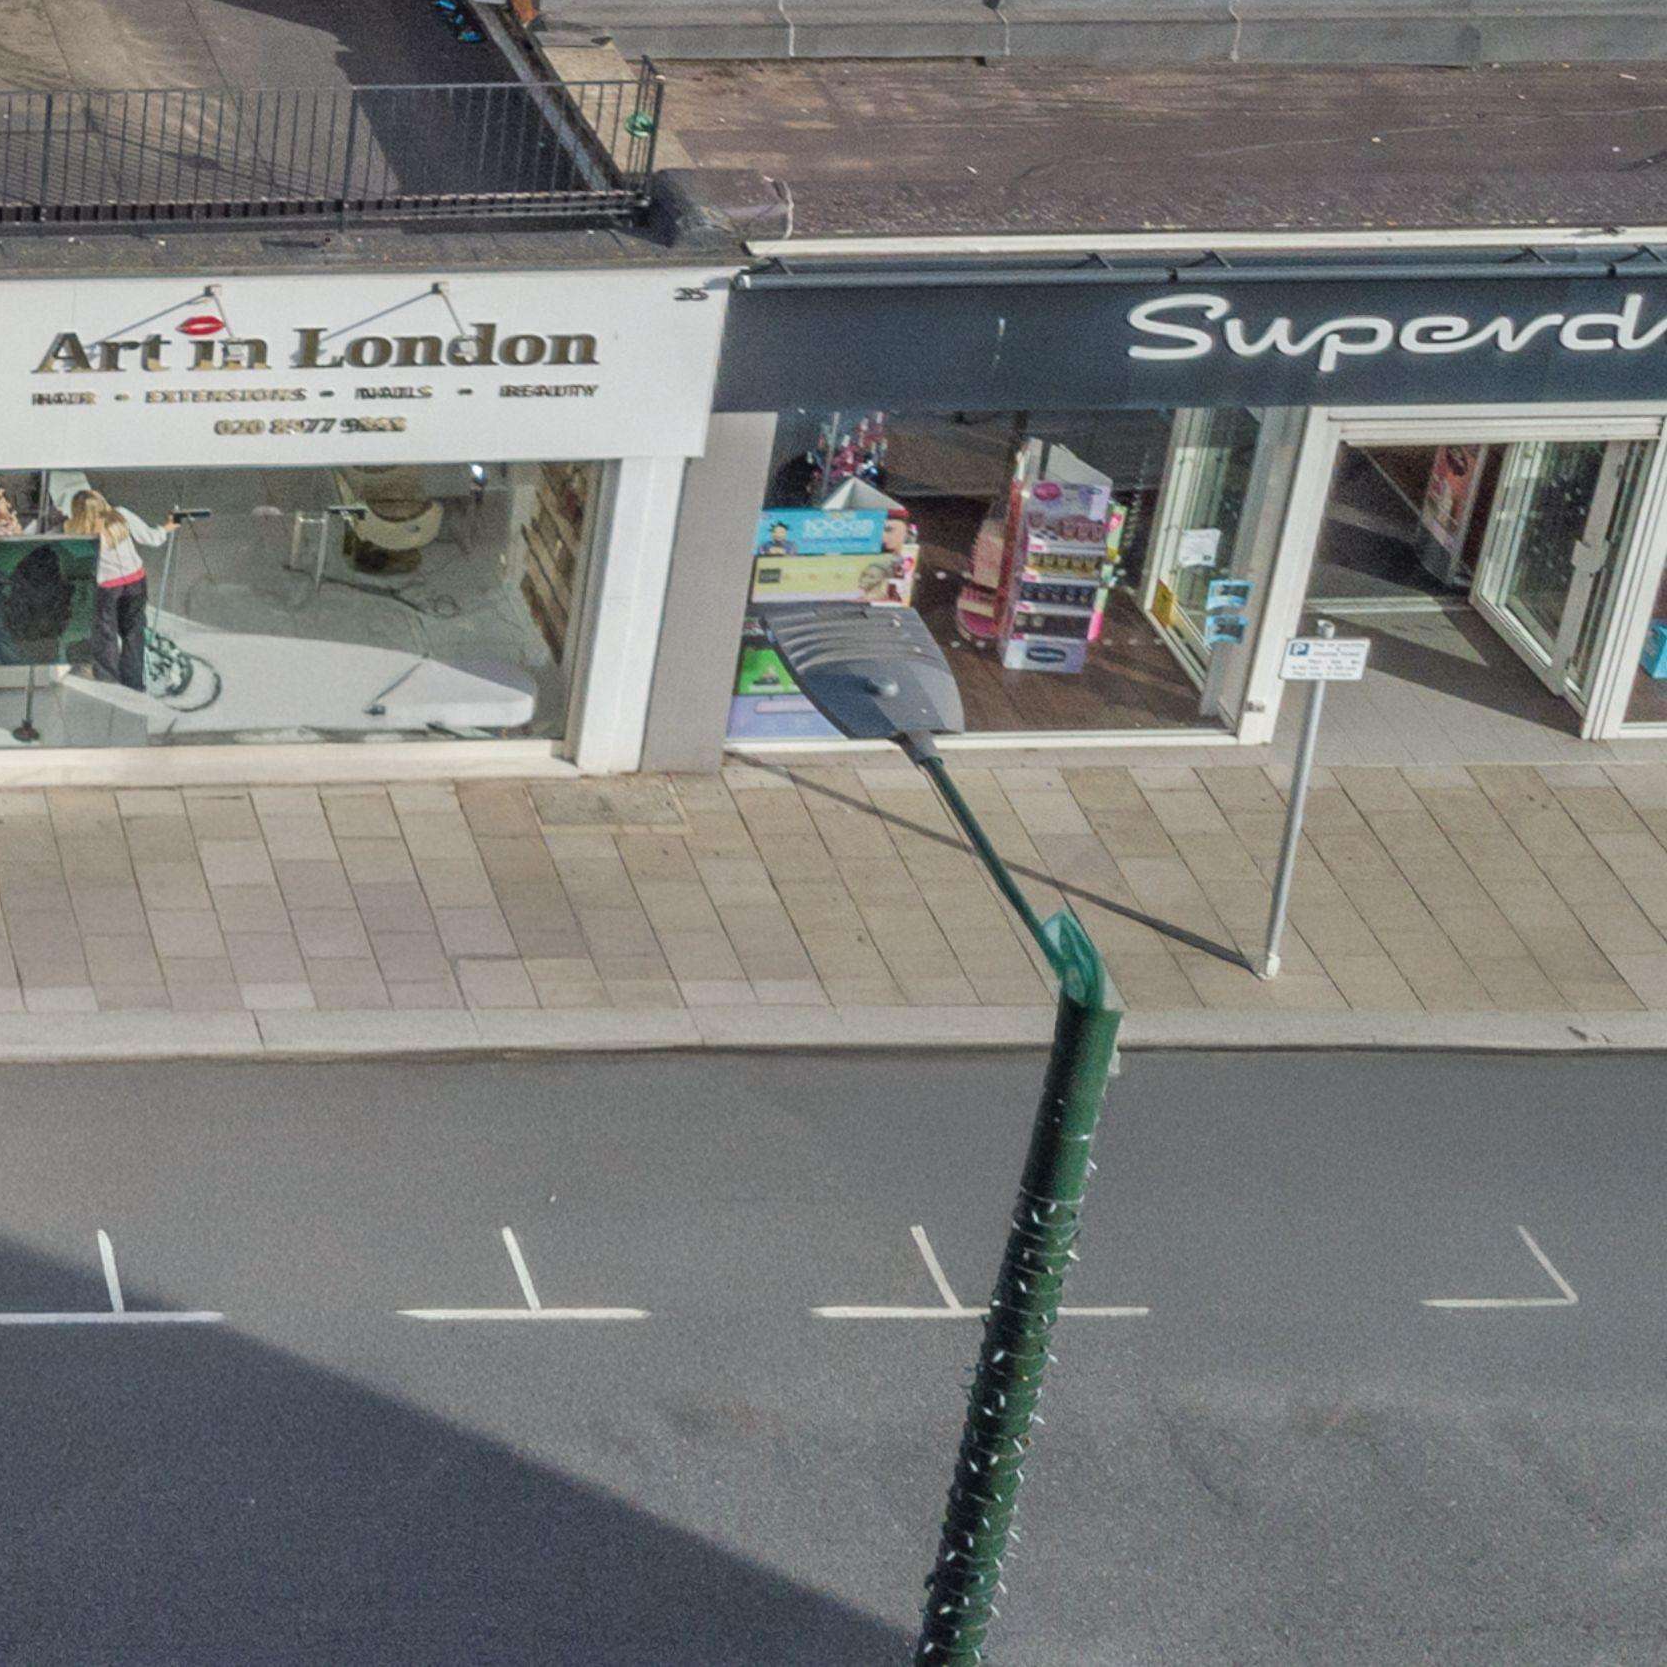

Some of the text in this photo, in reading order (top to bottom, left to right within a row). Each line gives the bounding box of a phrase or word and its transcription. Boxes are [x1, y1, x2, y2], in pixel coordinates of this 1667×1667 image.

[31, 323, 600, 373] Art in London
